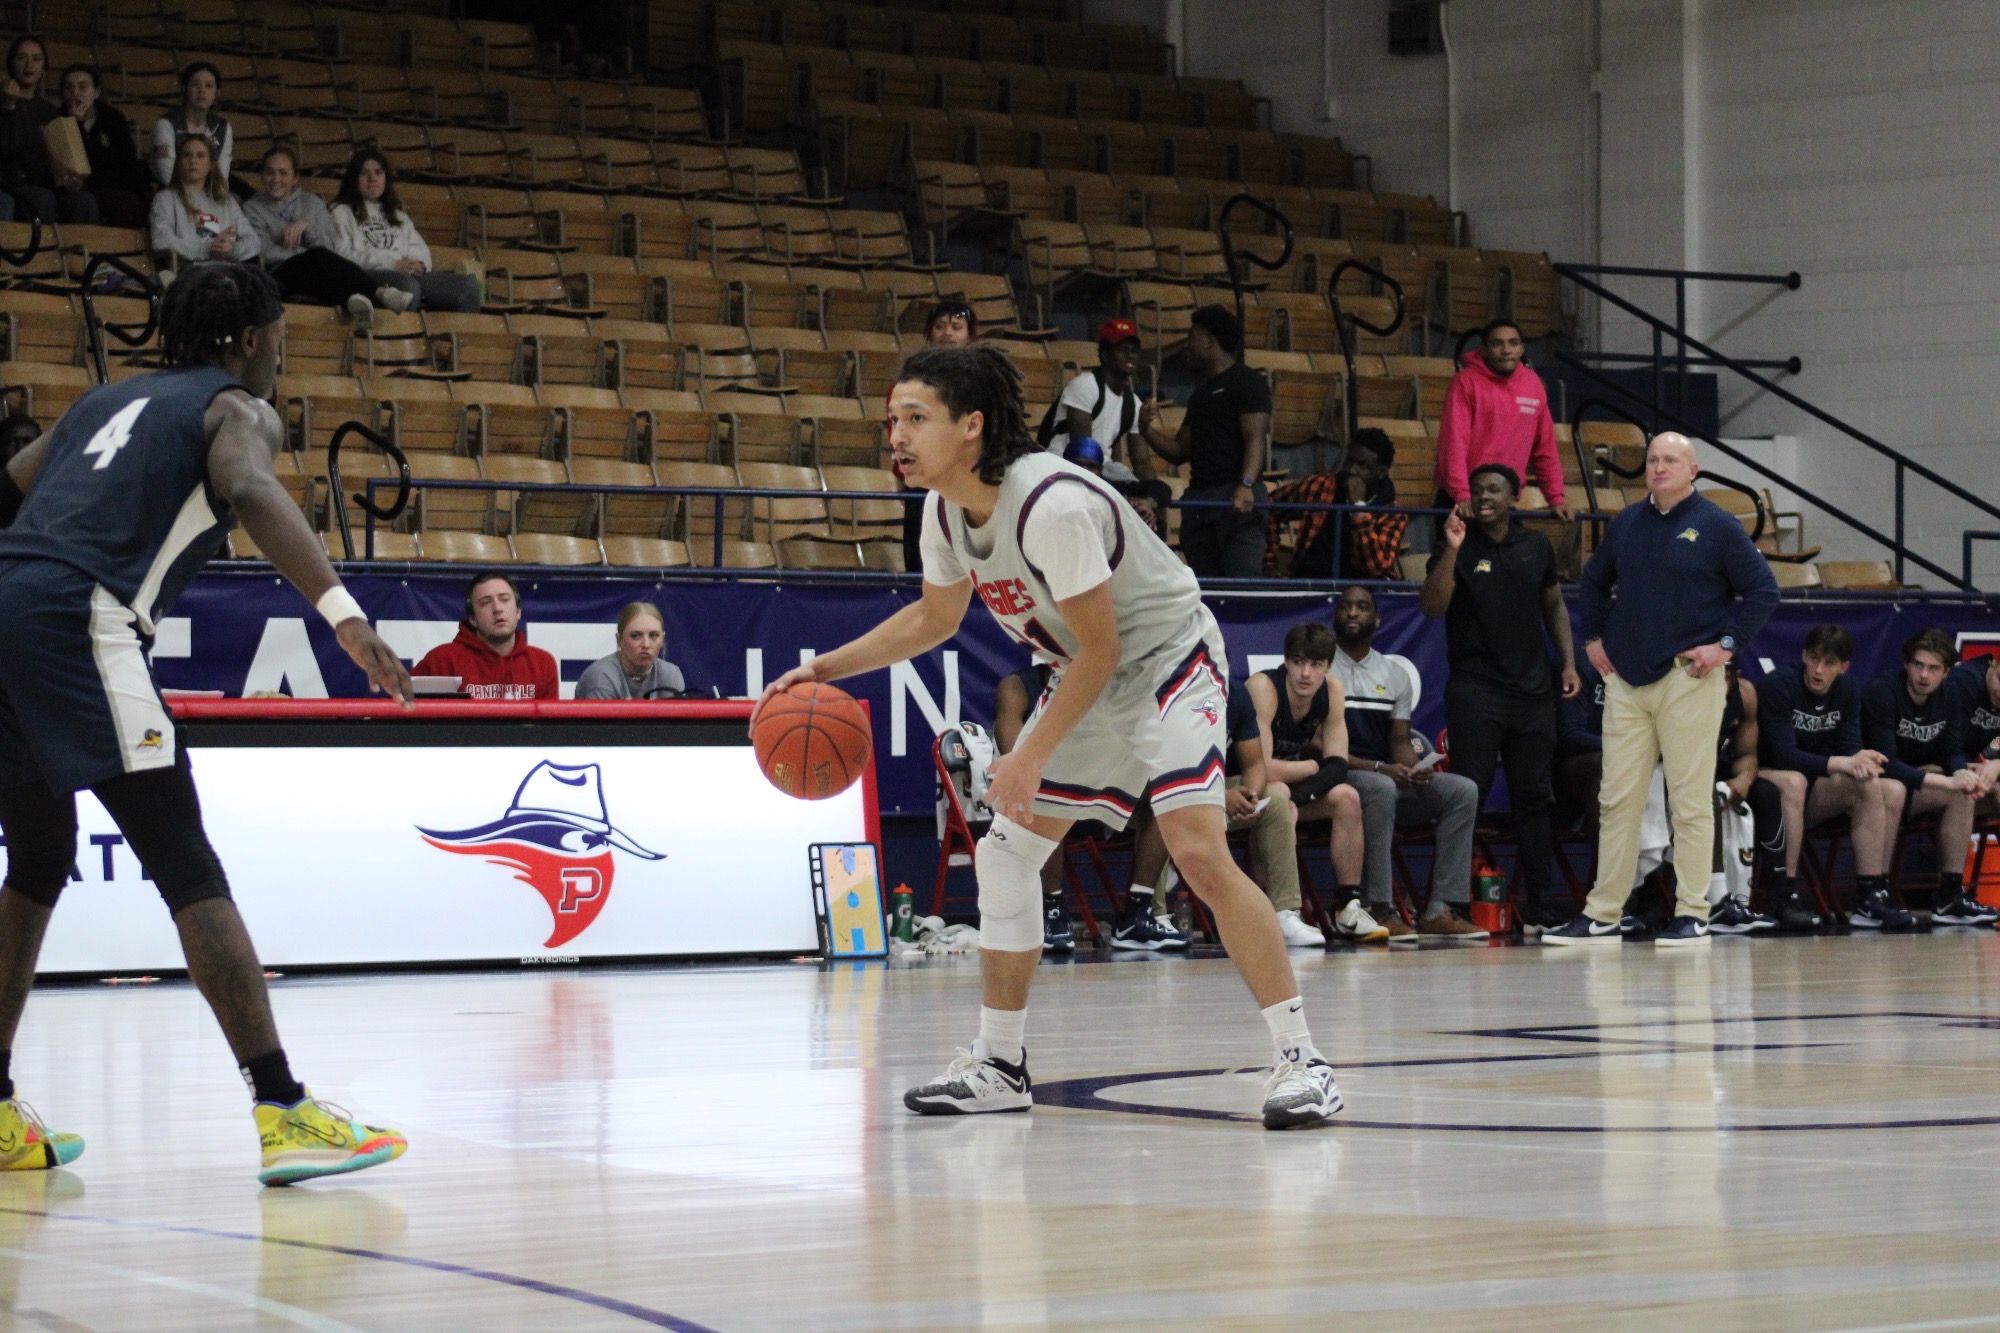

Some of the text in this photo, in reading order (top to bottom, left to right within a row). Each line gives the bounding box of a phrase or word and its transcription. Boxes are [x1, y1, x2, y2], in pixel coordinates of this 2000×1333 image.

[82, 397, 151, 470] 4
[558, 866, 603, 913] P
[521, 955, 580, 965] DAKTRONICS
